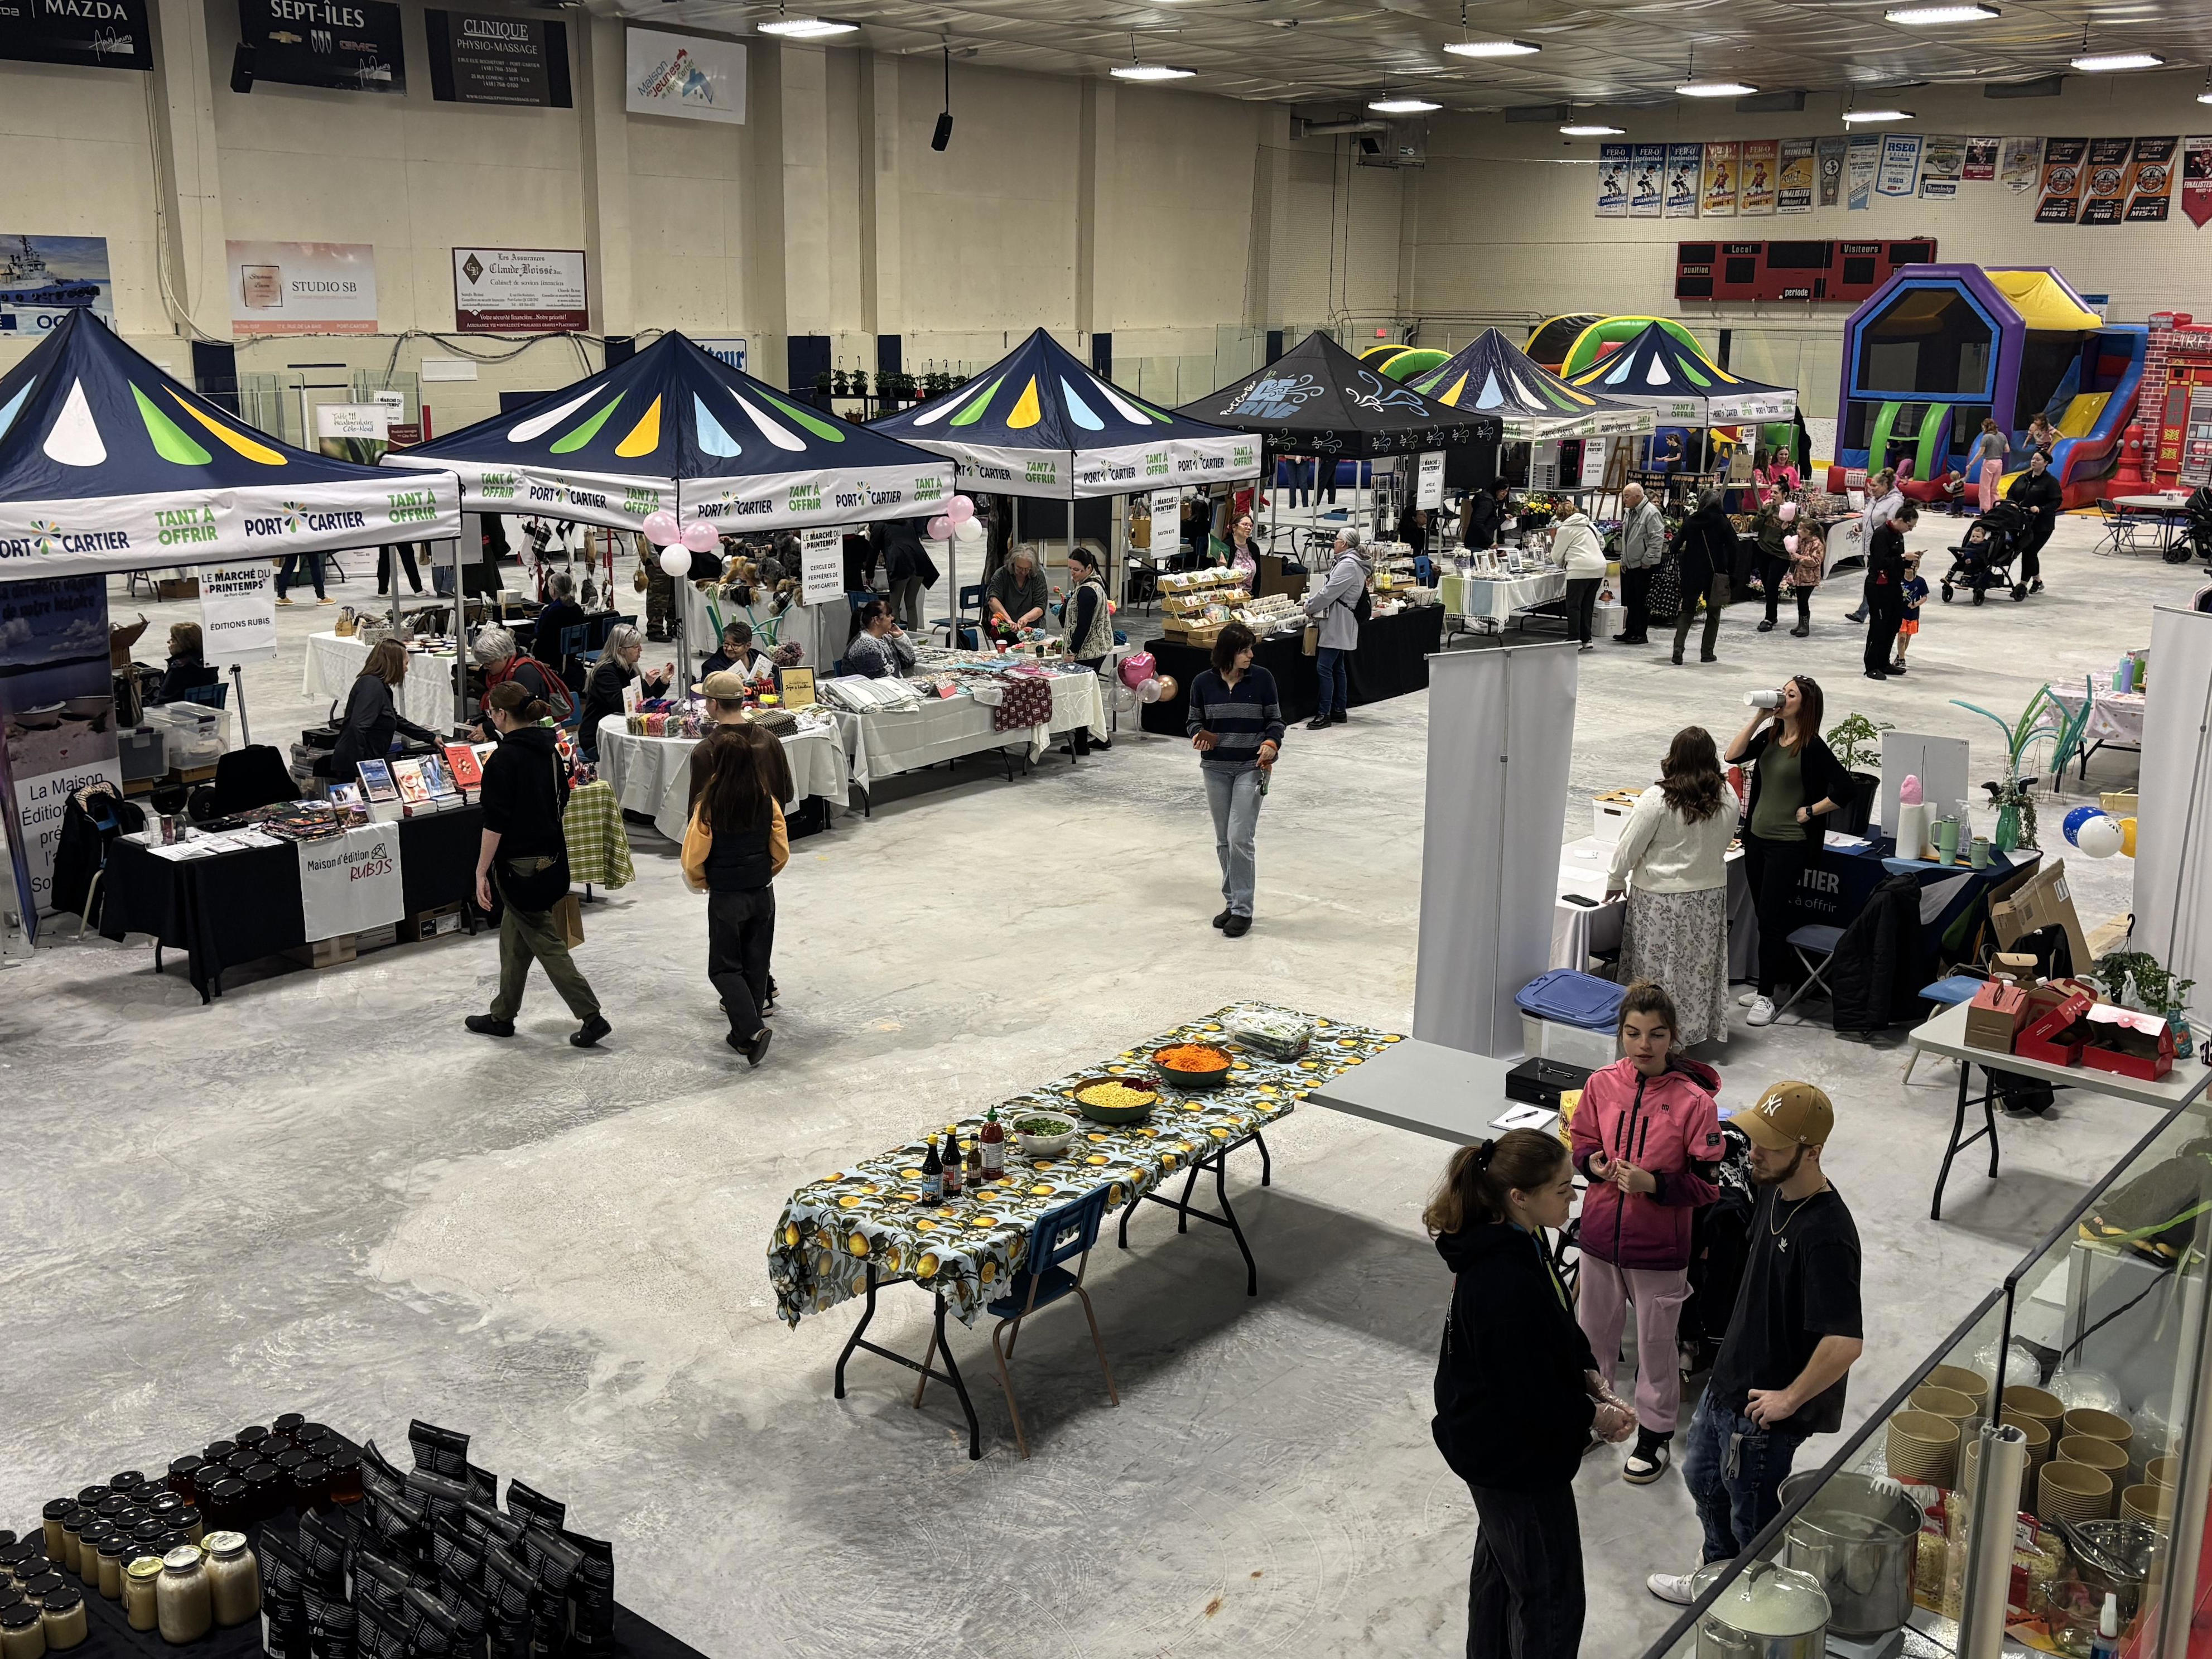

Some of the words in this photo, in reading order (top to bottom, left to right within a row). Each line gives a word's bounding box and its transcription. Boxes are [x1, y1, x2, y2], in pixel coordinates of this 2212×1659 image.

[46, 0, 128, 21] MAZDA
[271, 0, 365, 28] SEPT-ÎLES
[464, 19, 528, 40] CLINIQUE
[457, 38, 538, 55] PHYSIO-MASSAGE
[638, 60, 668, 96] Maison
[1732, 245, 1752, 253] Local
[1844, 244, 1878, 253] Visiteurs
[511, 253, 545, 262] Assurances
[489, 263, 519, 274] Claude
[522, 263, 553, 275] Boissé
[1683, 266, 1709, 274] punition
[292, 281, 340, 292] STUDIO
[343, 282, 357, 292] SB
[2172, 331, 2206, 351] FIRE
[1690, 402, 1695, 411] À
[1145, 452, 1160, 465] TANT
[1162, 449, 1169, 462] À
[1233, 446, 1247, 458] TANT
[1247, 445, 1254, 456] À
[1025, 461, 1049, 474] TANT
[1049, 460, 1056, 473] À
[1178, 459, 1193, 472] PORT
[1202, 457, 1224, 470] CARTIER
[1233, 456, 1253, 467] OFFRIR
[980, 466, 1011, 481] CARTIER
[1083, 471, 1101, 484] PORT
[1111, 466, 1136, 481] CARTIER
[1145, 463, 1169, 476] OFFRIR
[480, 472, 505, 485] TANT
[507, 470, 514, 484] À
[914, 477, 934, 489] TANT
[936, 475, 942, 488] À
[1025, 471, 1056, 485] OFFRIR
[482, 486, 514, 498] OFFRIR
[624, 487, 649, 500] TANT
[651, 489, 659, 503] À
[789, 484, 811, 498] TANT
[813, 481, 821, 496] À
[914, 488, 942, 501] OFFRIR
[387, 491, 423, 508] TANT
[427, 488, 437, 505] À
[529, 486, 555, 502] PORT
[570, 490, 608, 510] CARTIER
[788, 497, 822, 513] OFFRIR
[836, 493, 857, 508] PORT
[870, 490, 902, 505] CARTIER
[155, 508, 198, 528] TANT
[203, 504, 216, 523] À
[388, 506, 438, 524] OFFRIR
[697, 503, 724, 518] PORT
[736, 499, 773, 516] CARTIER
[244, 517, 283, 537] PORT
[307, 510, 366, 532] CARTIER
[158, 525, 219, 546] OFFRIR
[809, 530, 833, 541] MARCHÉ
[0, 538, 31, 558] ORT
[61, 531, 131, 553] CARTIER
[807, 538, 837, 549] PRINTEMPS
[201, 573, 213, 583] LE
[214, 568, 256, 582] MARCHÉ
[258, 568, 271, 578] DU
[808, 572, 832, 581] FERMIÈRES
[209, 579, 264, 594] PRINTEMPS
[808, 581, 838, 590] PORT-CARTIER
[210, 620, 247, 631] ÉDITIONS
[247, 616, 271, 627] RUBIS
[30, 785, 47, 801] La
[52, 773, 104, 795] Maison
[307, 859, 336, 872] Maison
[337, 850, 369, 865] d'édition
[1797, 868, 1839, 894] TIER
[1805, 898, 1837, 913] offrir
